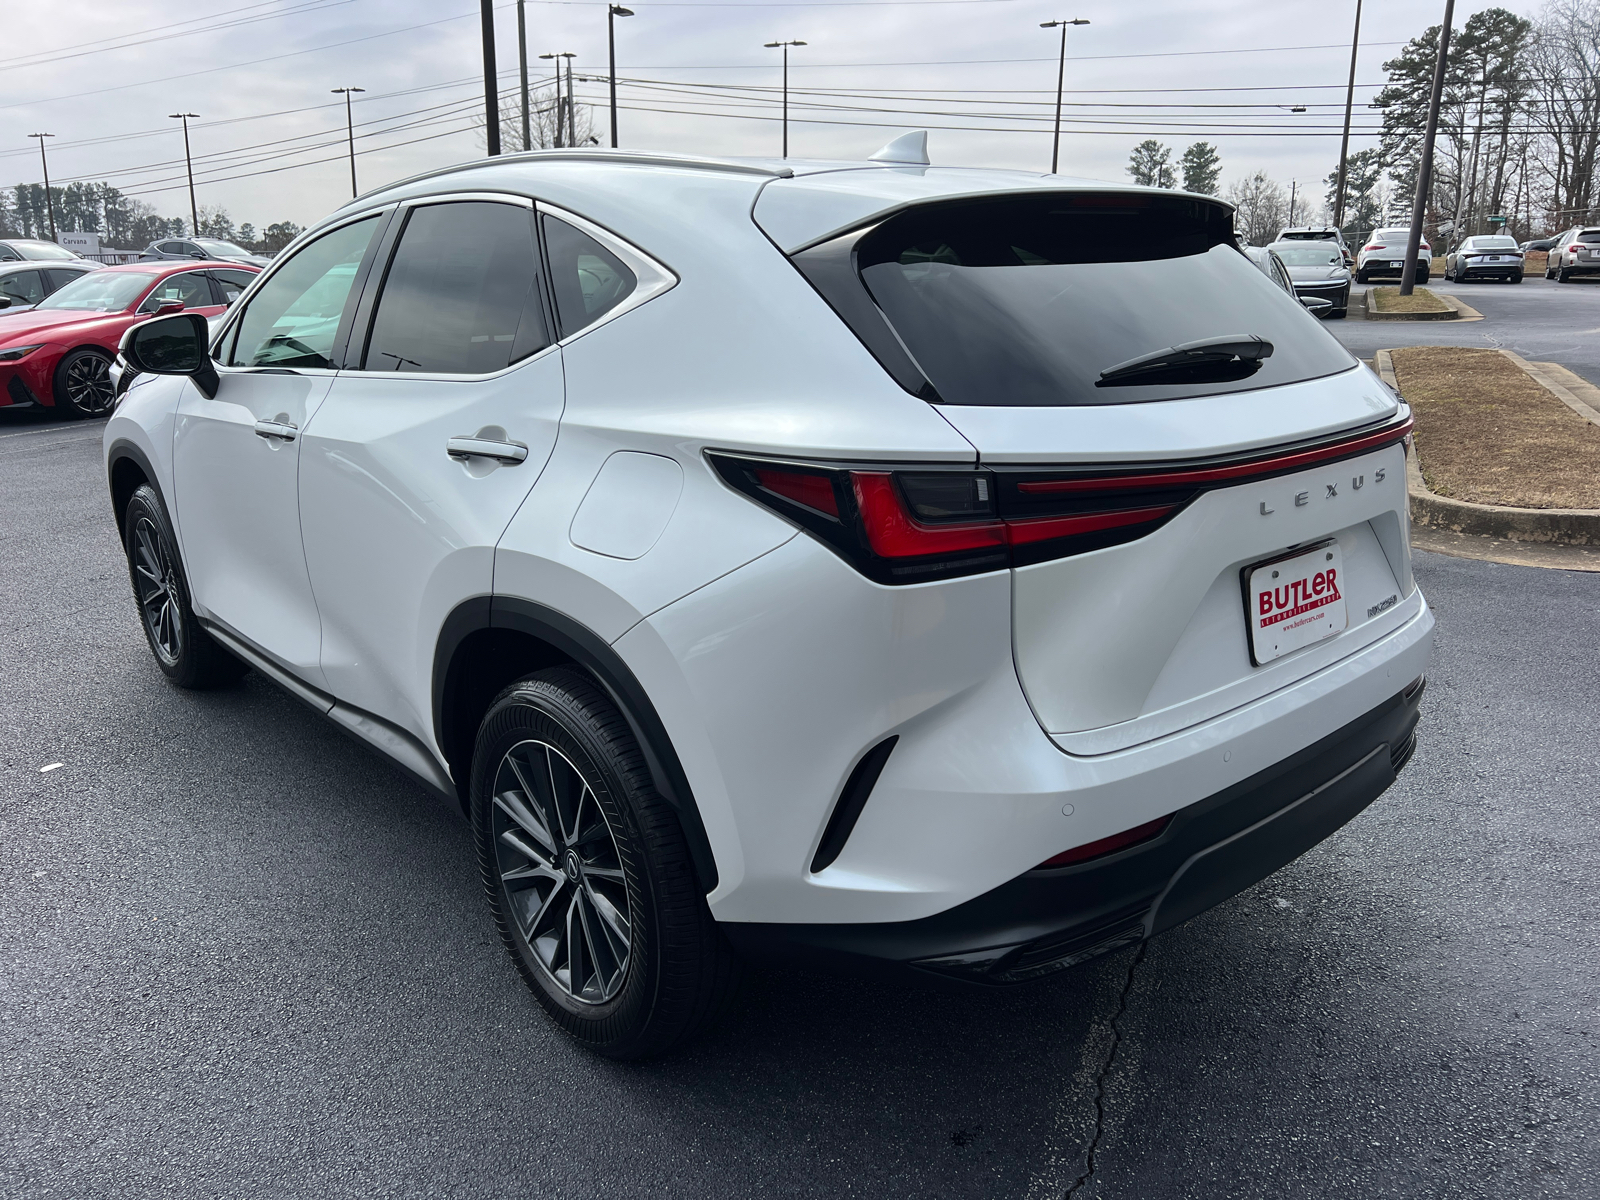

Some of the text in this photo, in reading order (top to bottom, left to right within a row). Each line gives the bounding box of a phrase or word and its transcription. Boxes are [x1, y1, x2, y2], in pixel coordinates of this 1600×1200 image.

[63, 237, 87, 245] Carvana
[1259, 467, 1386, 516] LEXUS
[1261, 592, 1340, 627] AUTOMOTIVE GROUP
[1283, 612, 1325, 632] www.butlercars.com
